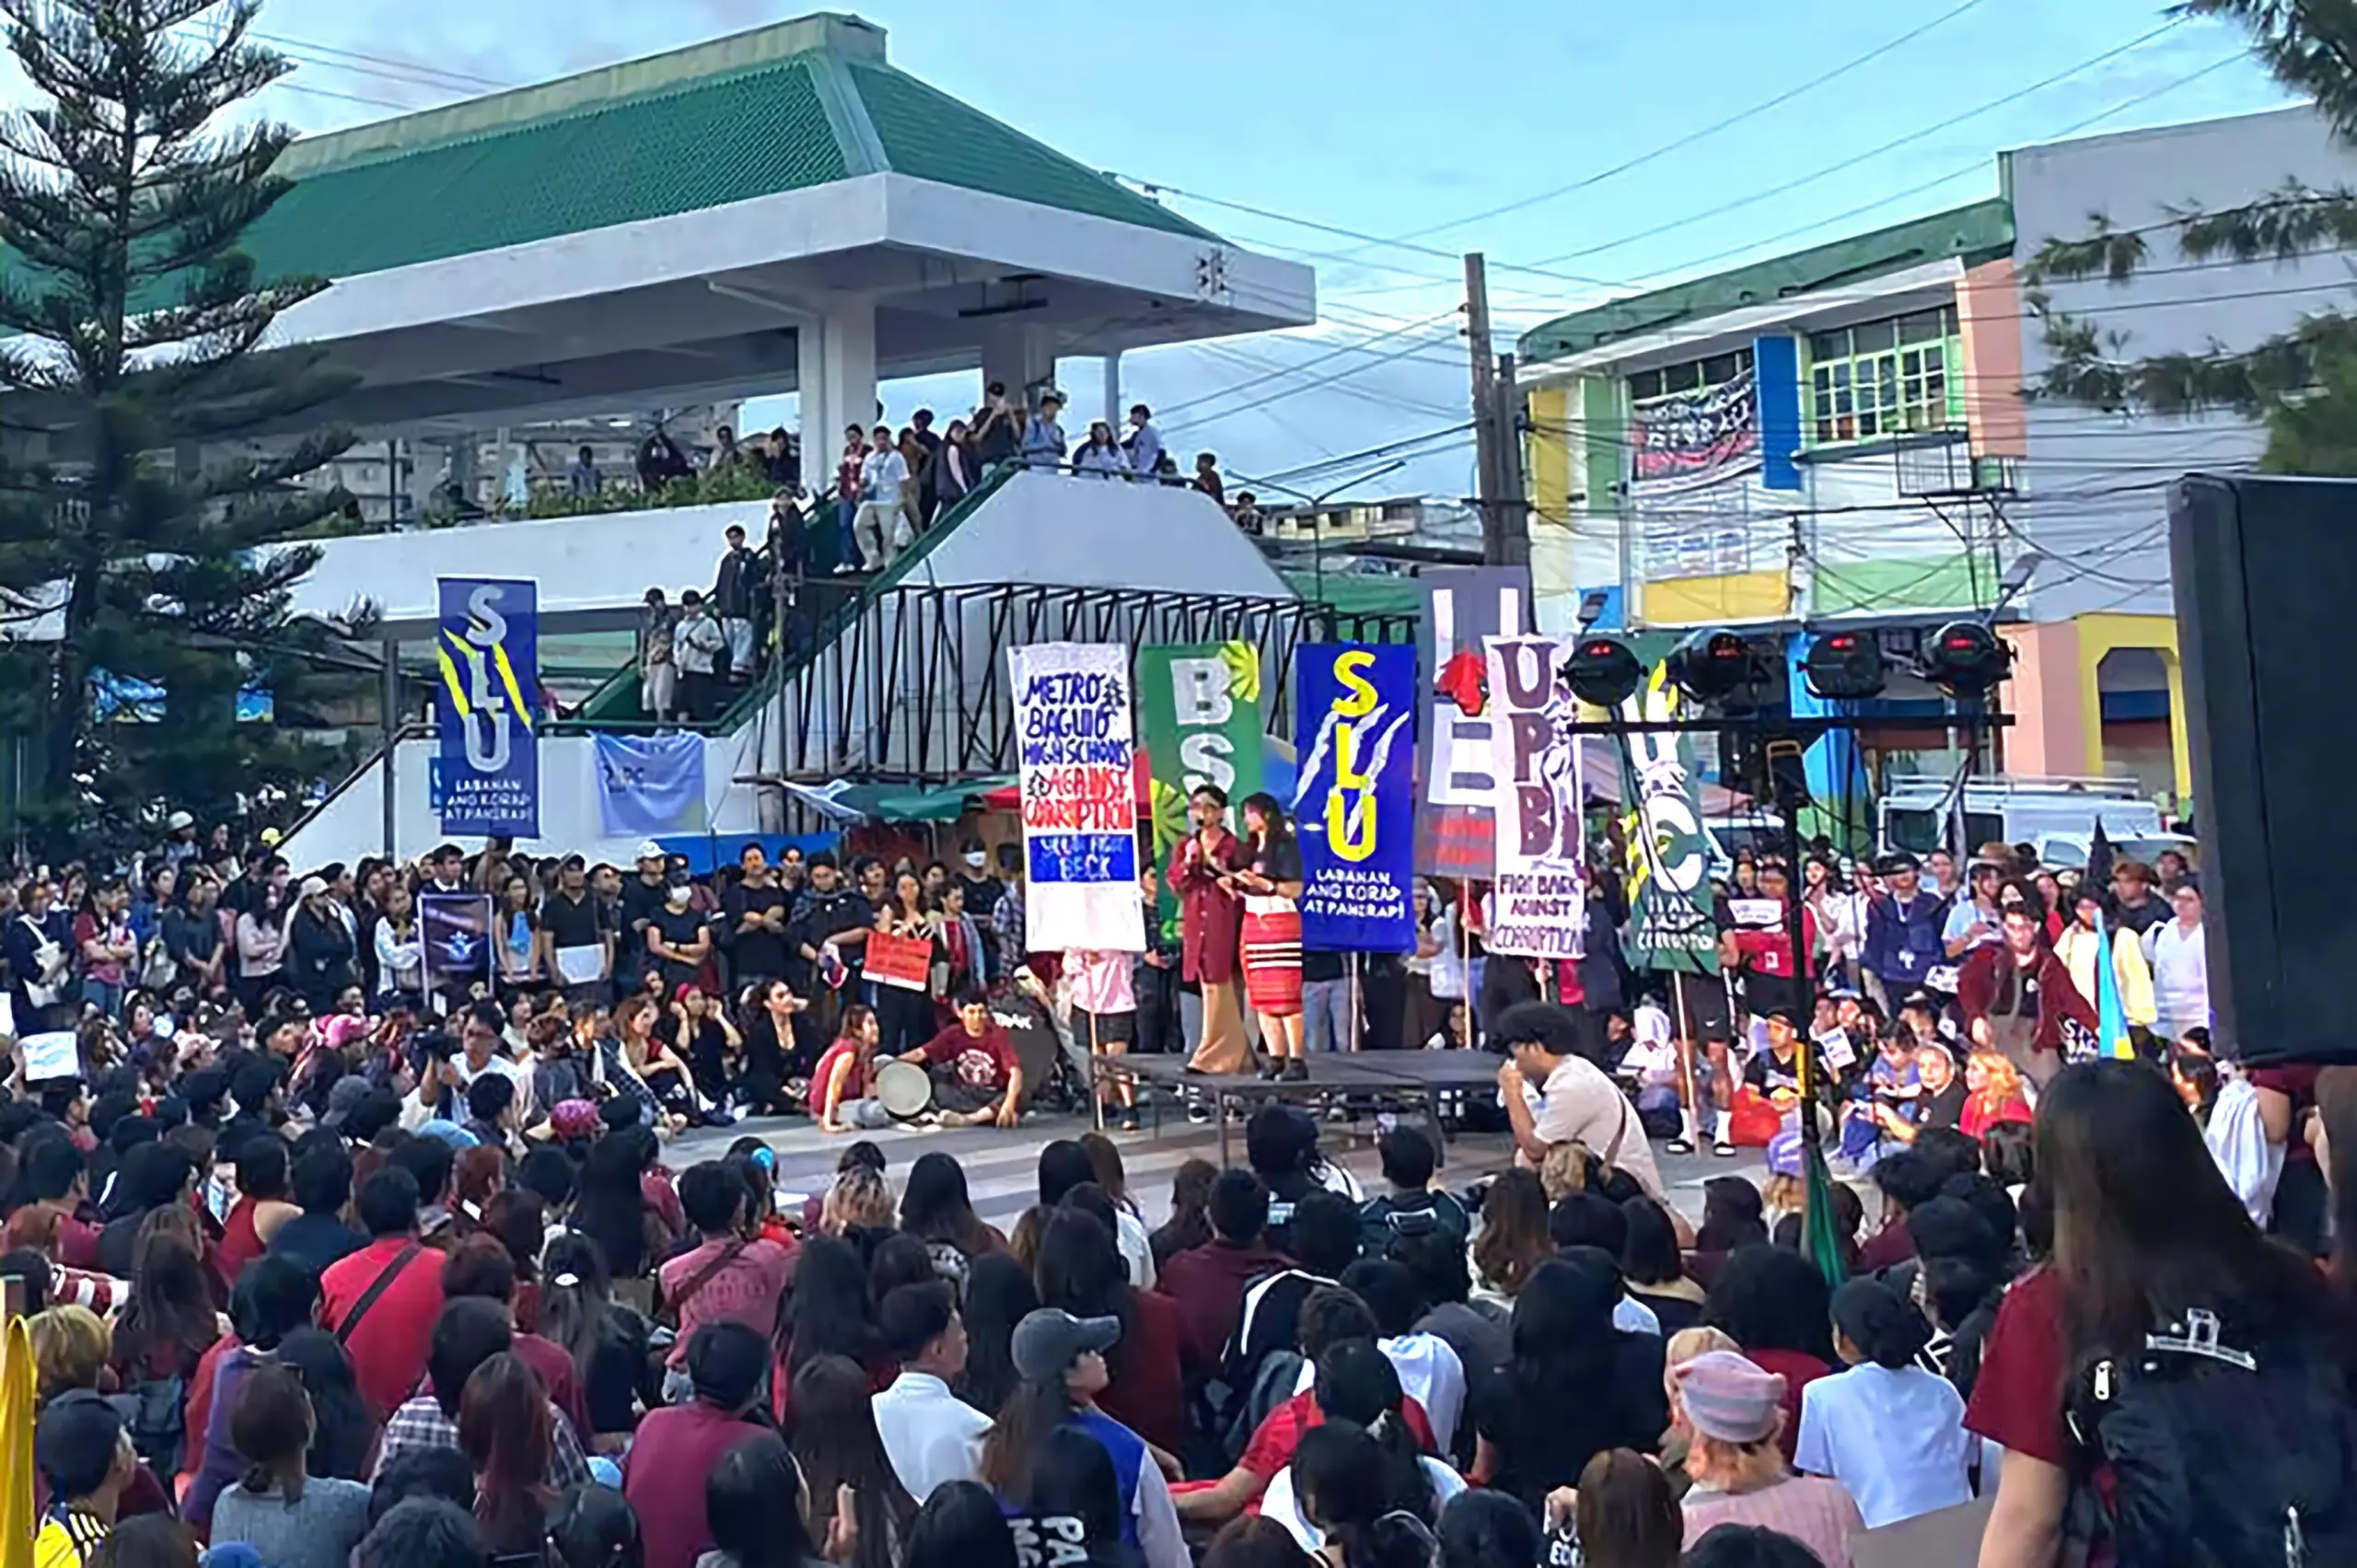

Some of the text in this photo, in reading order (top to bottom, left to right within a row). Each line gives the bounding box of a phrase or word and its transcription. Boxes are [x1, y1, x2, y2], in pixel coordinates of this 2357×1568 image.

[465, 585, 510, 772] SLU
[1019, 671, 1107, 707] METRO
[1026, 705, 1111, 739] BAGUIO
[1328, 650, 1378, 862] SLU
[1306, 883, 1401, 901] ANG KORAP
[1316, 868, 1390, 886] LABANAN
[1304, 900, 1324, 914] AT
